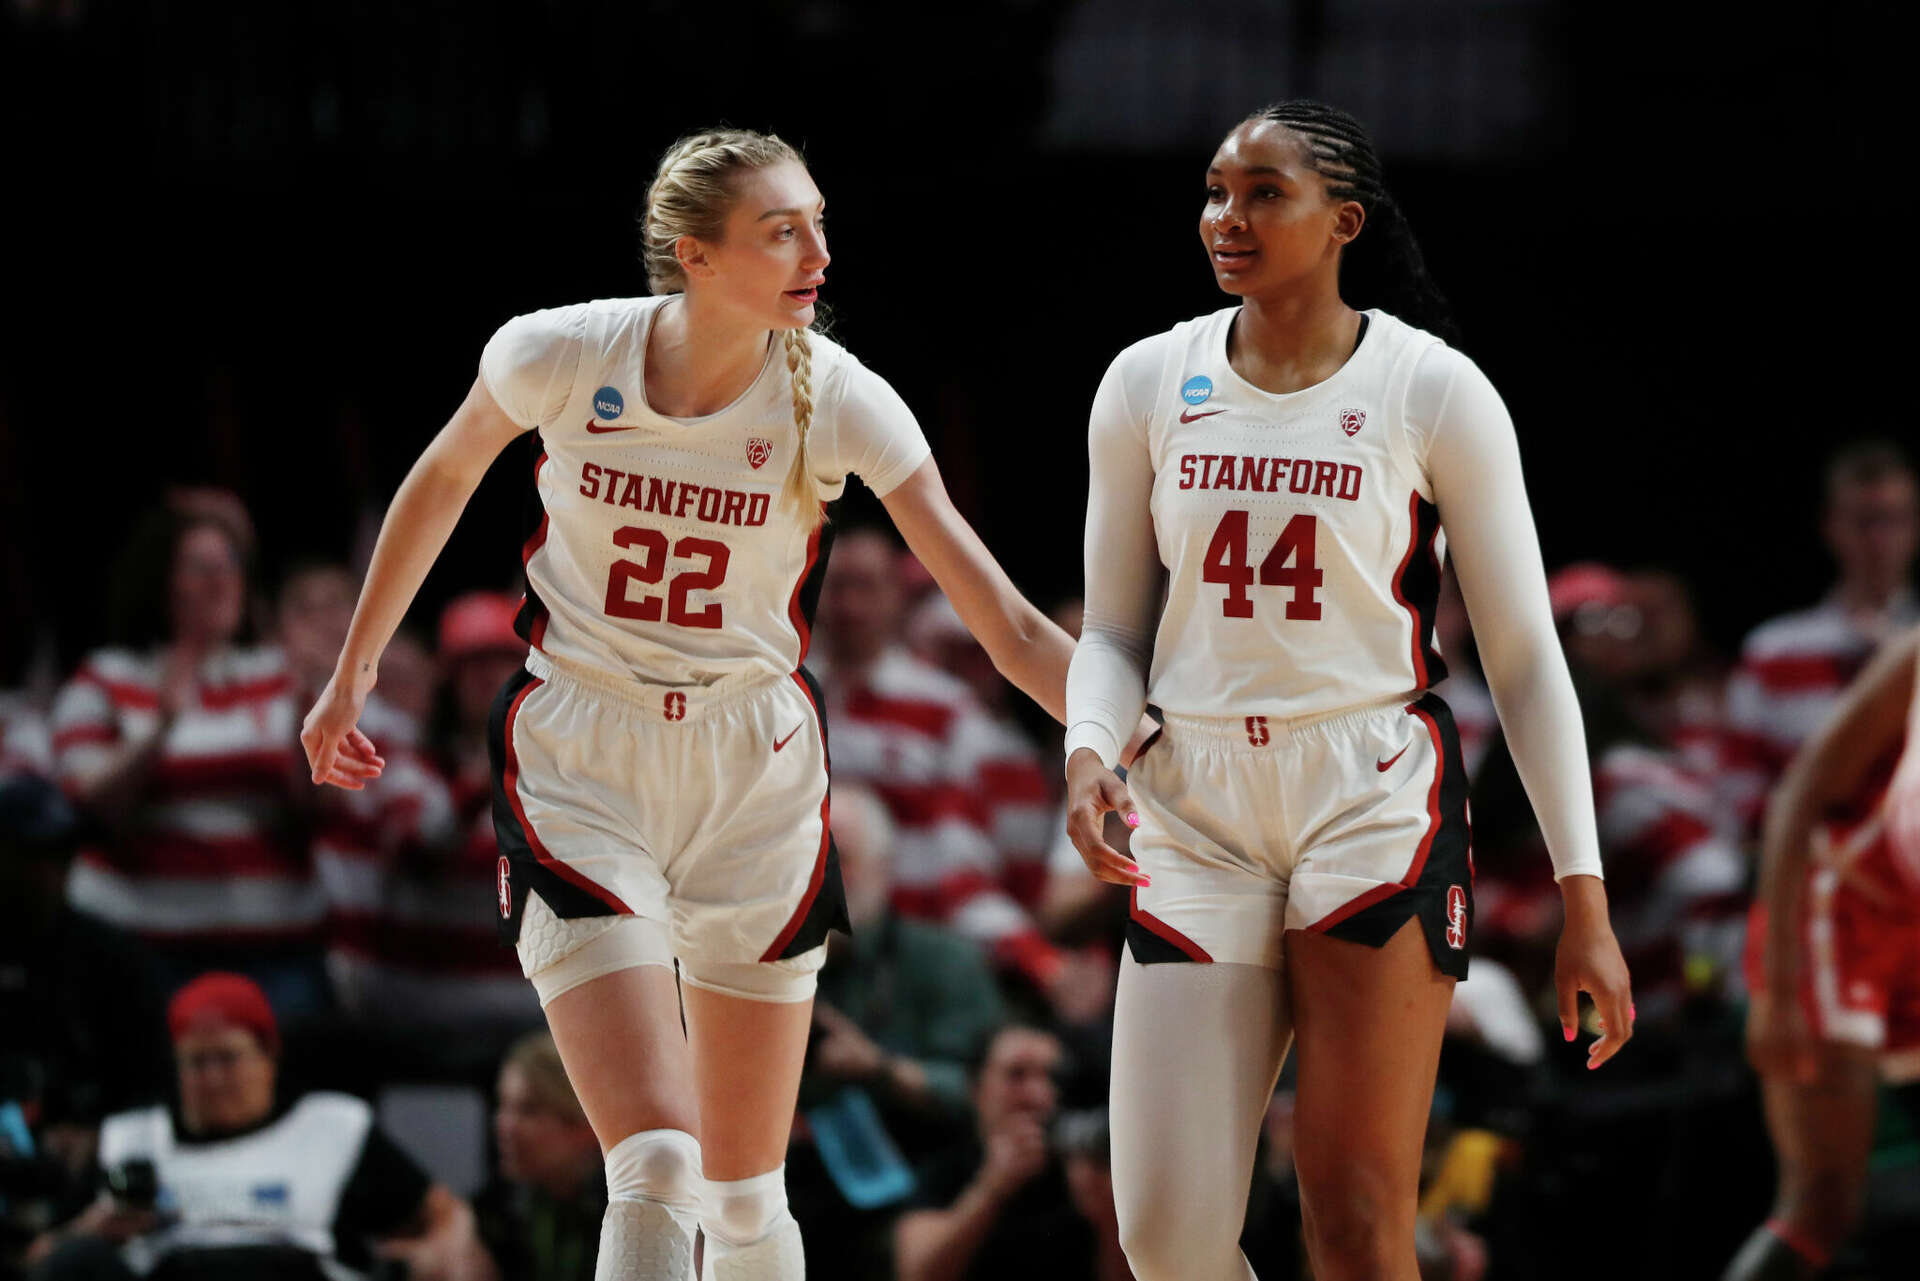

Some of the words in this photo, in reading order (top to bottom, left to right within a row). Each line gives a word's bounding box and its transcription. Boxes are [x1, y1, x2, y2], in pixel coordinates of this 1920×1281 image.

[597, 400, 620, 415] NCAA
[1341, 409, 1366, 426] PAC
[1344, 420, 1358, 432] 12
[746, 438, 773, 457] PAC
[751, 451, 764, 464] 12
[1179, 454, 1363, 501] STANFORD
[579, 462, 771, 527] STANFORD
[1203, 510, 1323, 621] 44
[604, 525, 731, 629] 22
